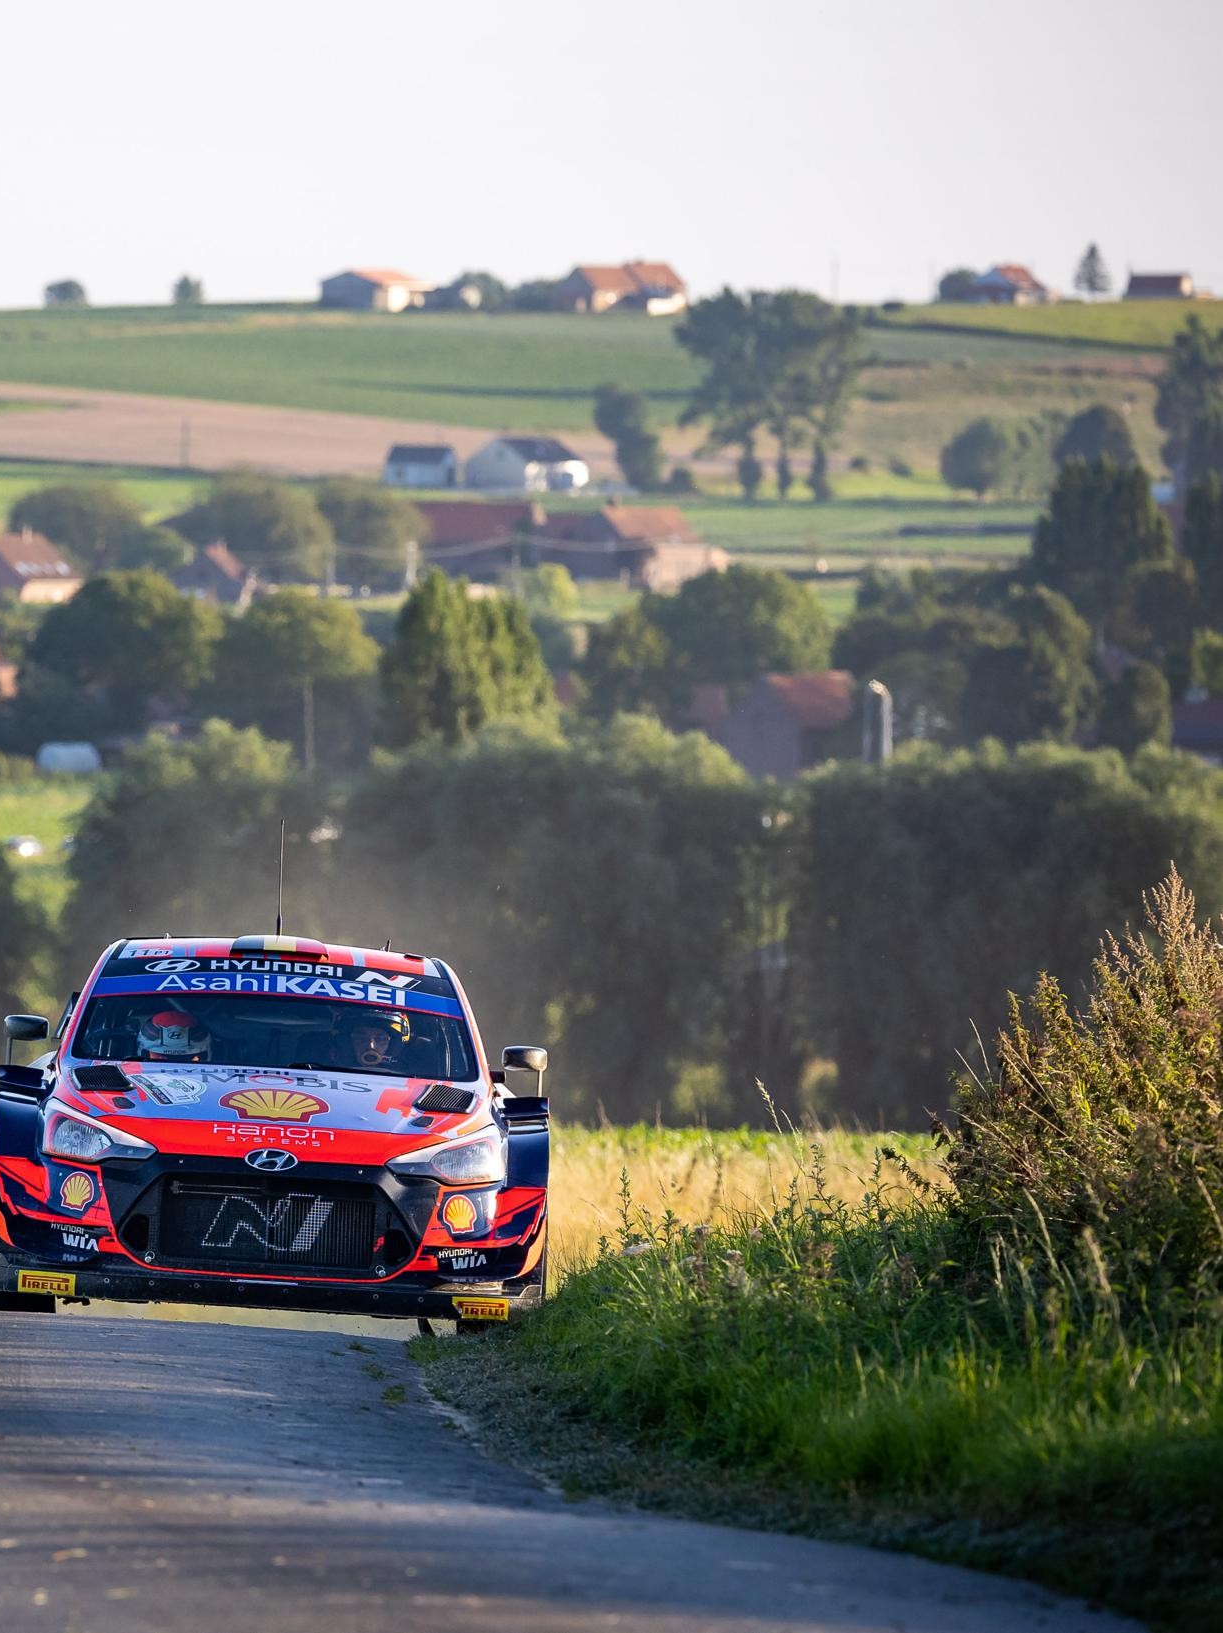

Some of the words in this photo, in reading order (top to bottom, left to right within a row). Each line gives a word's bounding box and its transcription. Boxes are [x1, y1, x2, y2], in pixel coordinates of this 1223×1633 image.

[210, 959, 343, 977] HYUNDAI
[201, 1073, 372, 1093] MOBIS
[213, 1123, 335, 1141] Hanon
[226, 1135, 321, 1147] SYSTEMS
[50, 1222, 85, 1234] HYUNDAI
[438, 1248, 473, 1259] HYUNDAI
[21, 1274, 71, 1292] PIRELLI
[458, 1301, 506, 1317] PIRELLI
